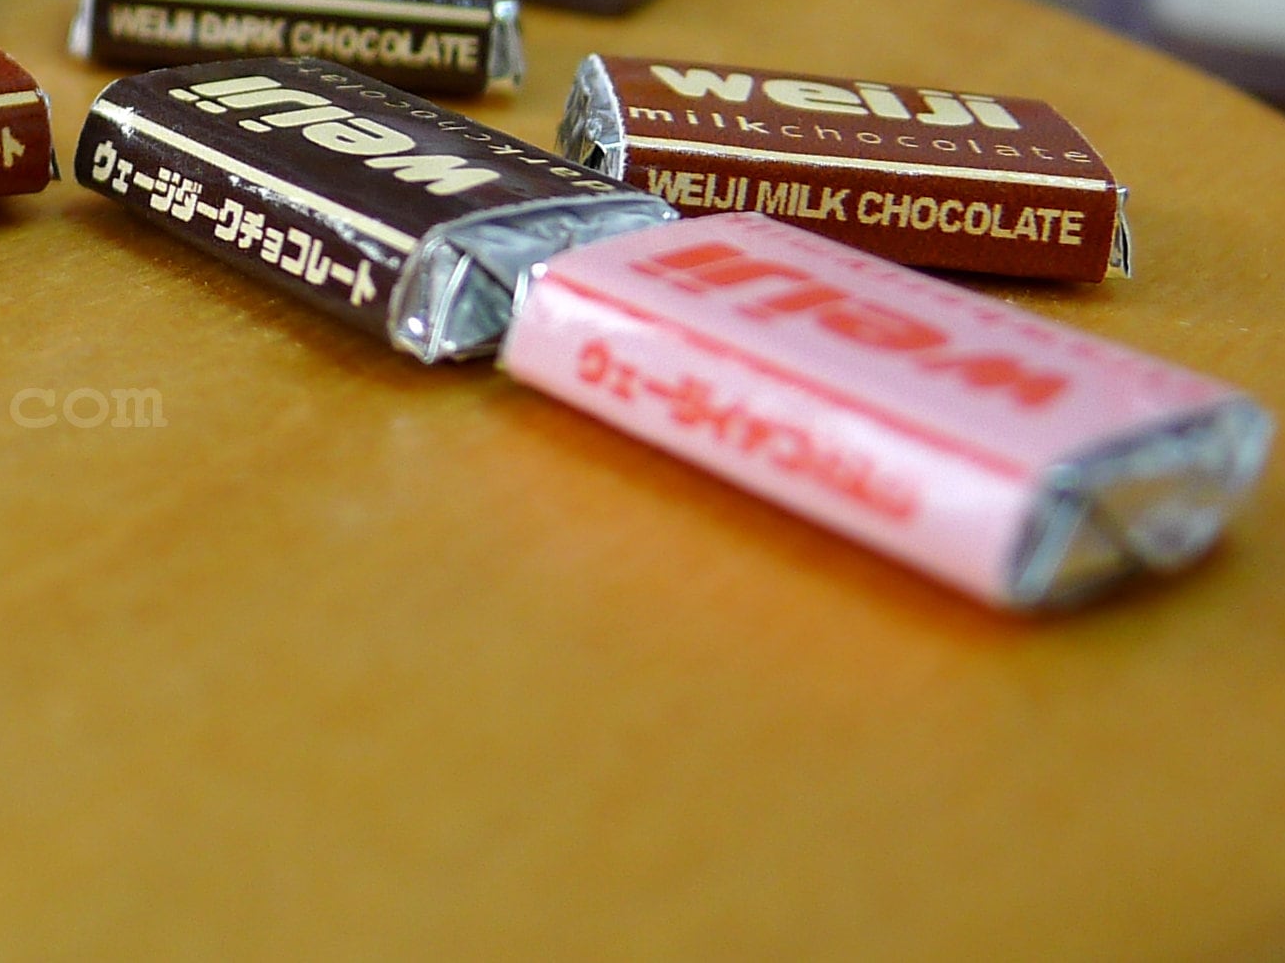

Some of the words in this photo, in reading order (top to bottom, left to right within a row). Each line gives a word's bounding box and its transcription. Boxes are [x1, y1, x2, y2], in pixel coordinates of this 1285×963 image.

[198, 11, 286, 55] DARK
[292, 20, 479, 75] CHOCOLATE
[168, 75, 502, 196] weiji
[649, 64, 1021, 131] weiji
[92, 139, 378, 307] ウェージダークチョコレート
[647, 168, 749, 212] WEIJI
[755, 182, 848, 223] MILK
[857, 189, 1086, 247] CHOCOLATE
